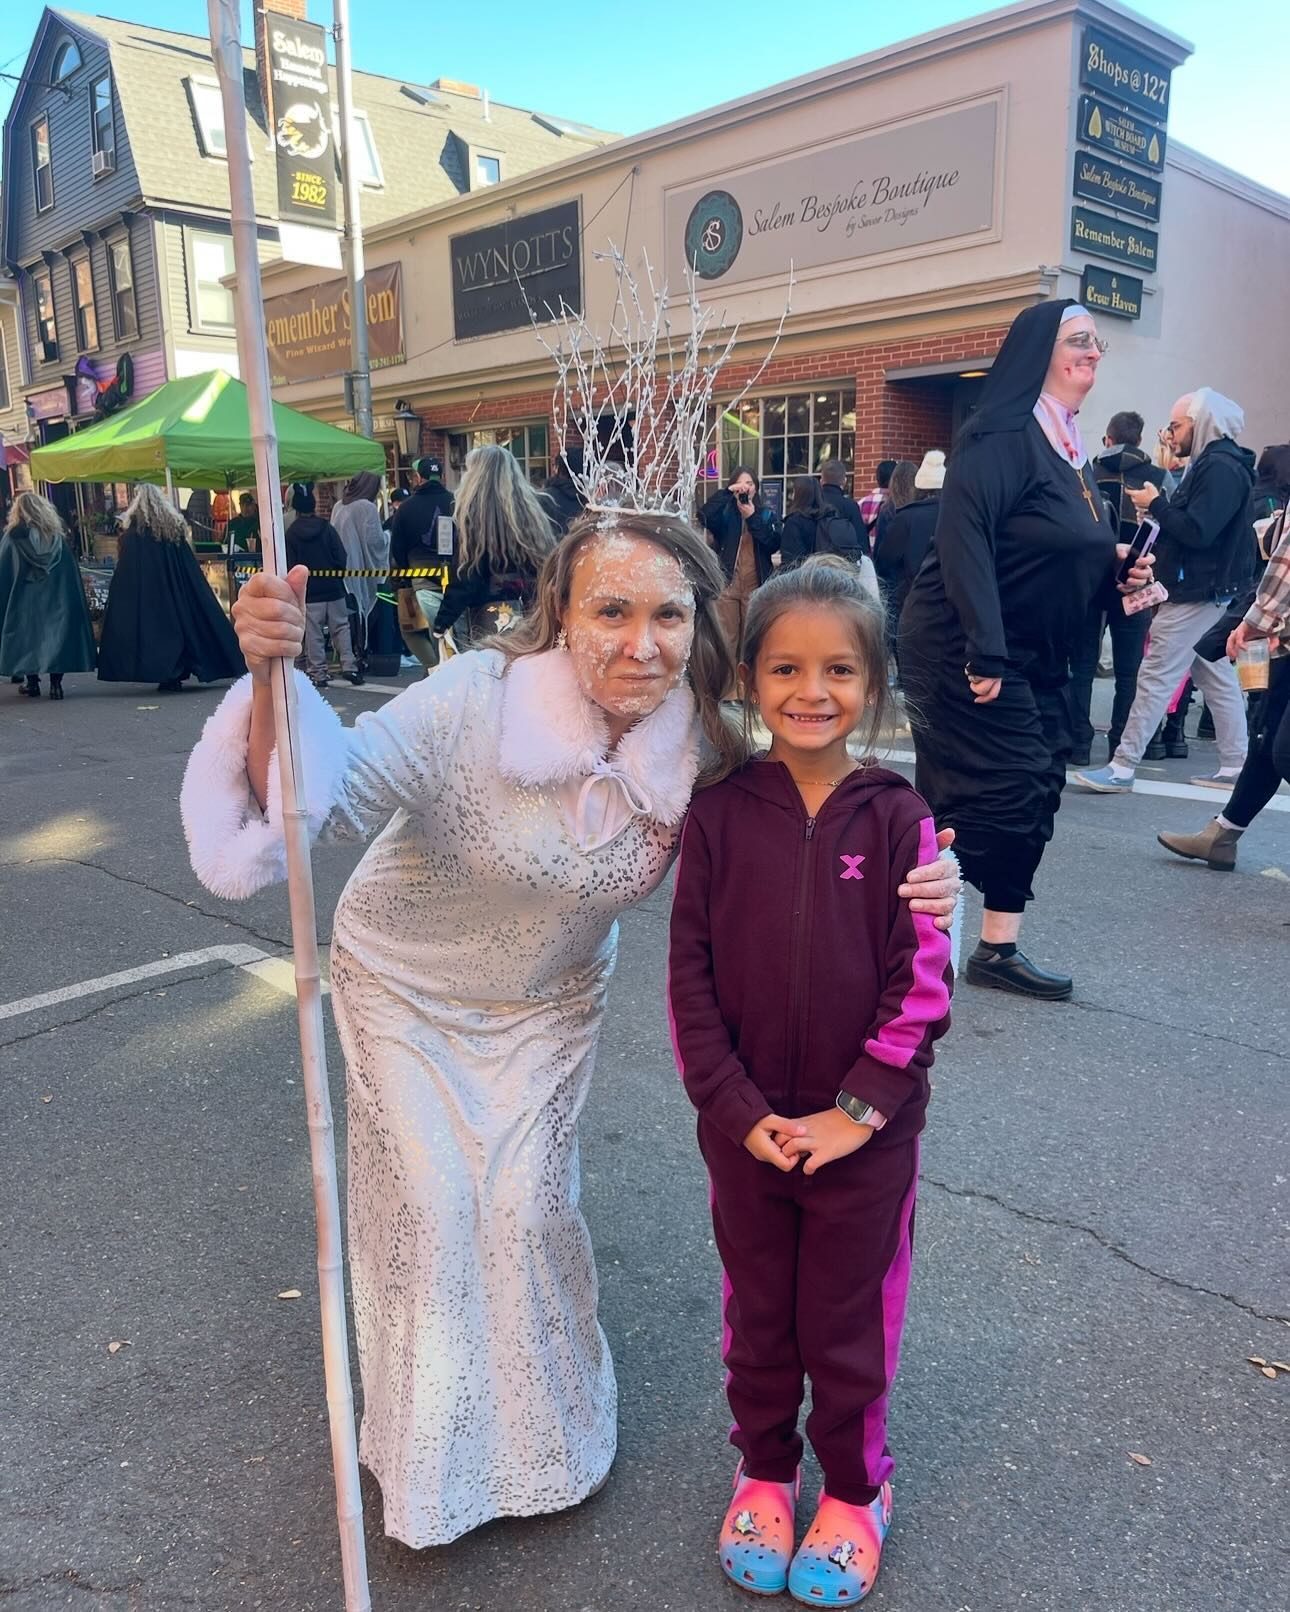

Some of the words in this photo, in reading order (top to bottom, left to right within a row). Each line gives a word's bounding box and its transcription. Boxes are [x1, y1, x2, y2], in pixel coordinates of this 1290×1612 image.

[273, 30, 324, 67] Salem
[1119, 116, 1135, 131] SALEM
[1080, 163, 1102, 185] Salem
[291, 182, 327, 205] 1982
[748, 202, 795, 236] Salem
[800, 180, 867, 233] Bespoke
[872, 169, 960, 208] Boutique
[456, 225, 574, 284] WYNOTTS
[1074, 219, 1126, 250] Remember
[1127, 235, 1155, 259] Salem
[267, 298, 339, 347] emember
[342, 284, 396, 330] Slem
[1086, 285, 1110, 306] Crow
[1111, 291, 1138, 314] Haven
[306, 341, 336, 354] Wizard
